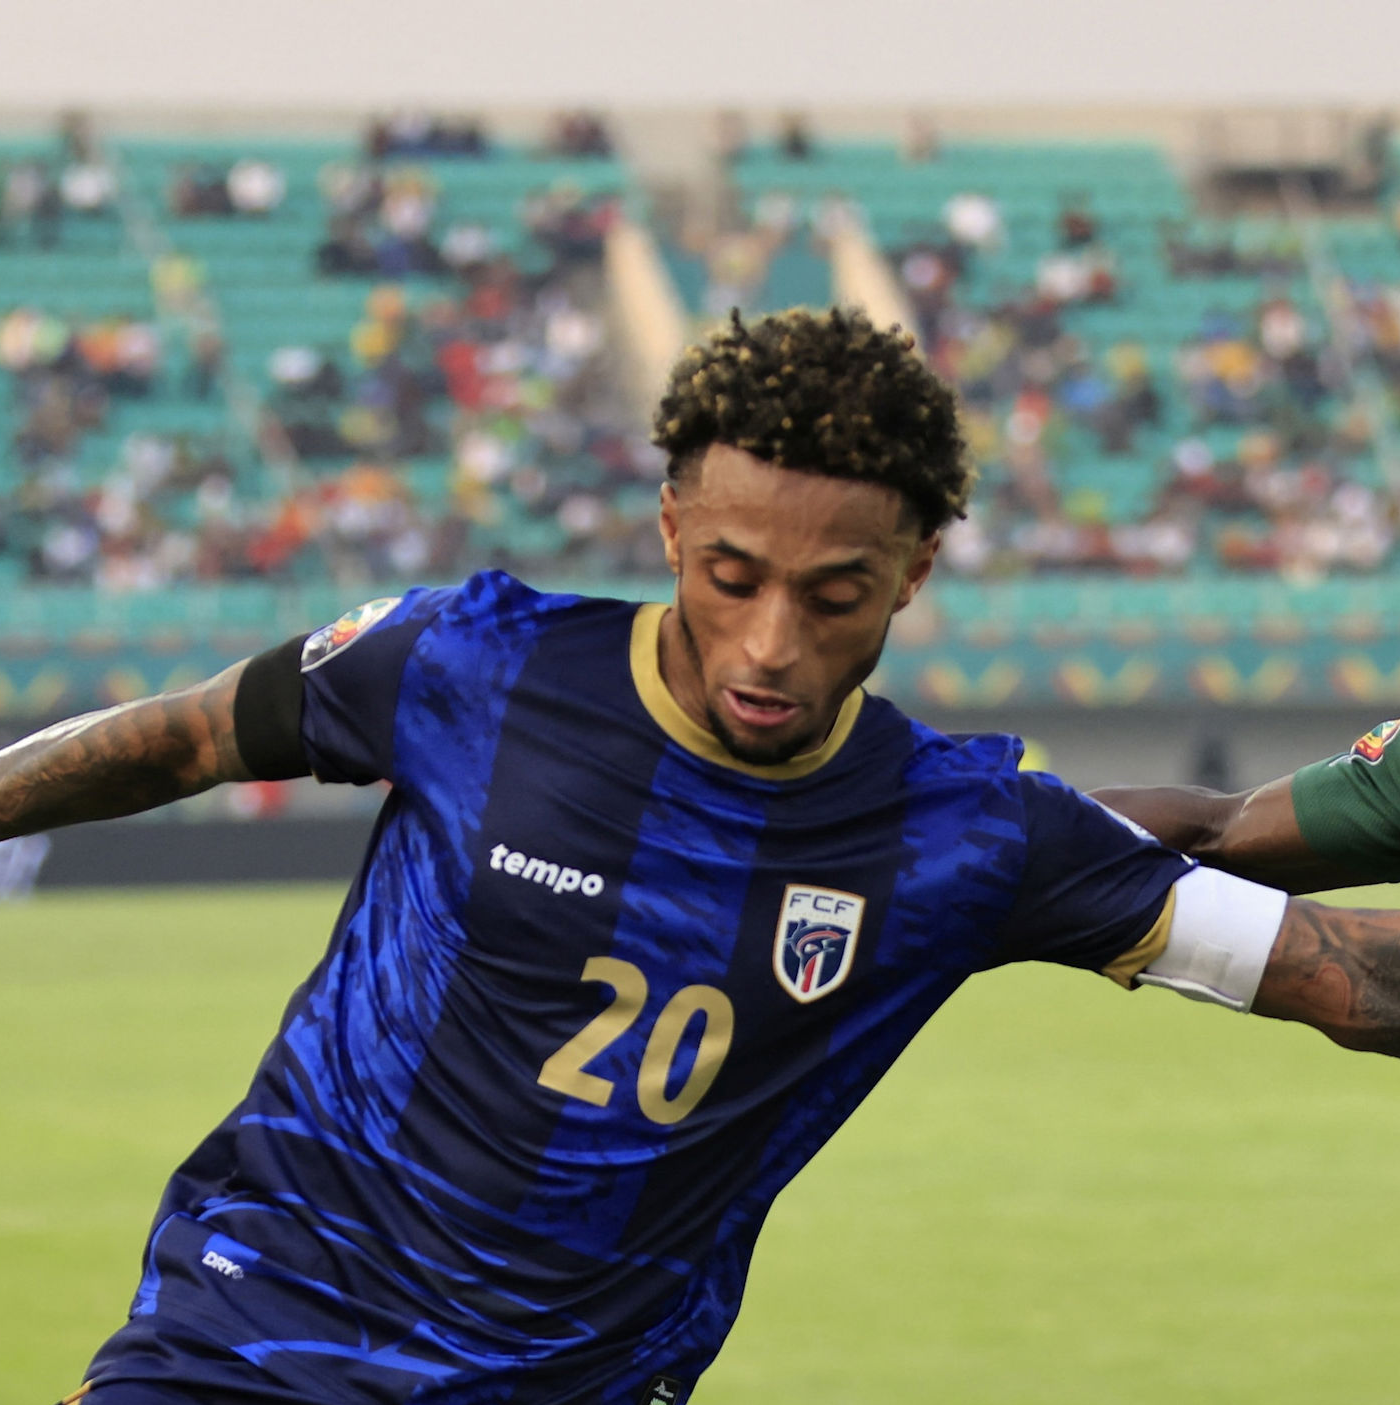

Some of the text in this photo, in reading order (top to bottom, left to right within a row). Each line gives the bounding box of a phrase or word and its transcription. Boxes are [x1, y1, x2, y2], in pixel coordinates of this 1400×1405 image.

[489, 842, 605, 897] tempo
[789, 892, 855, 915] FCF
[536, 955, 735, 1125] 20
